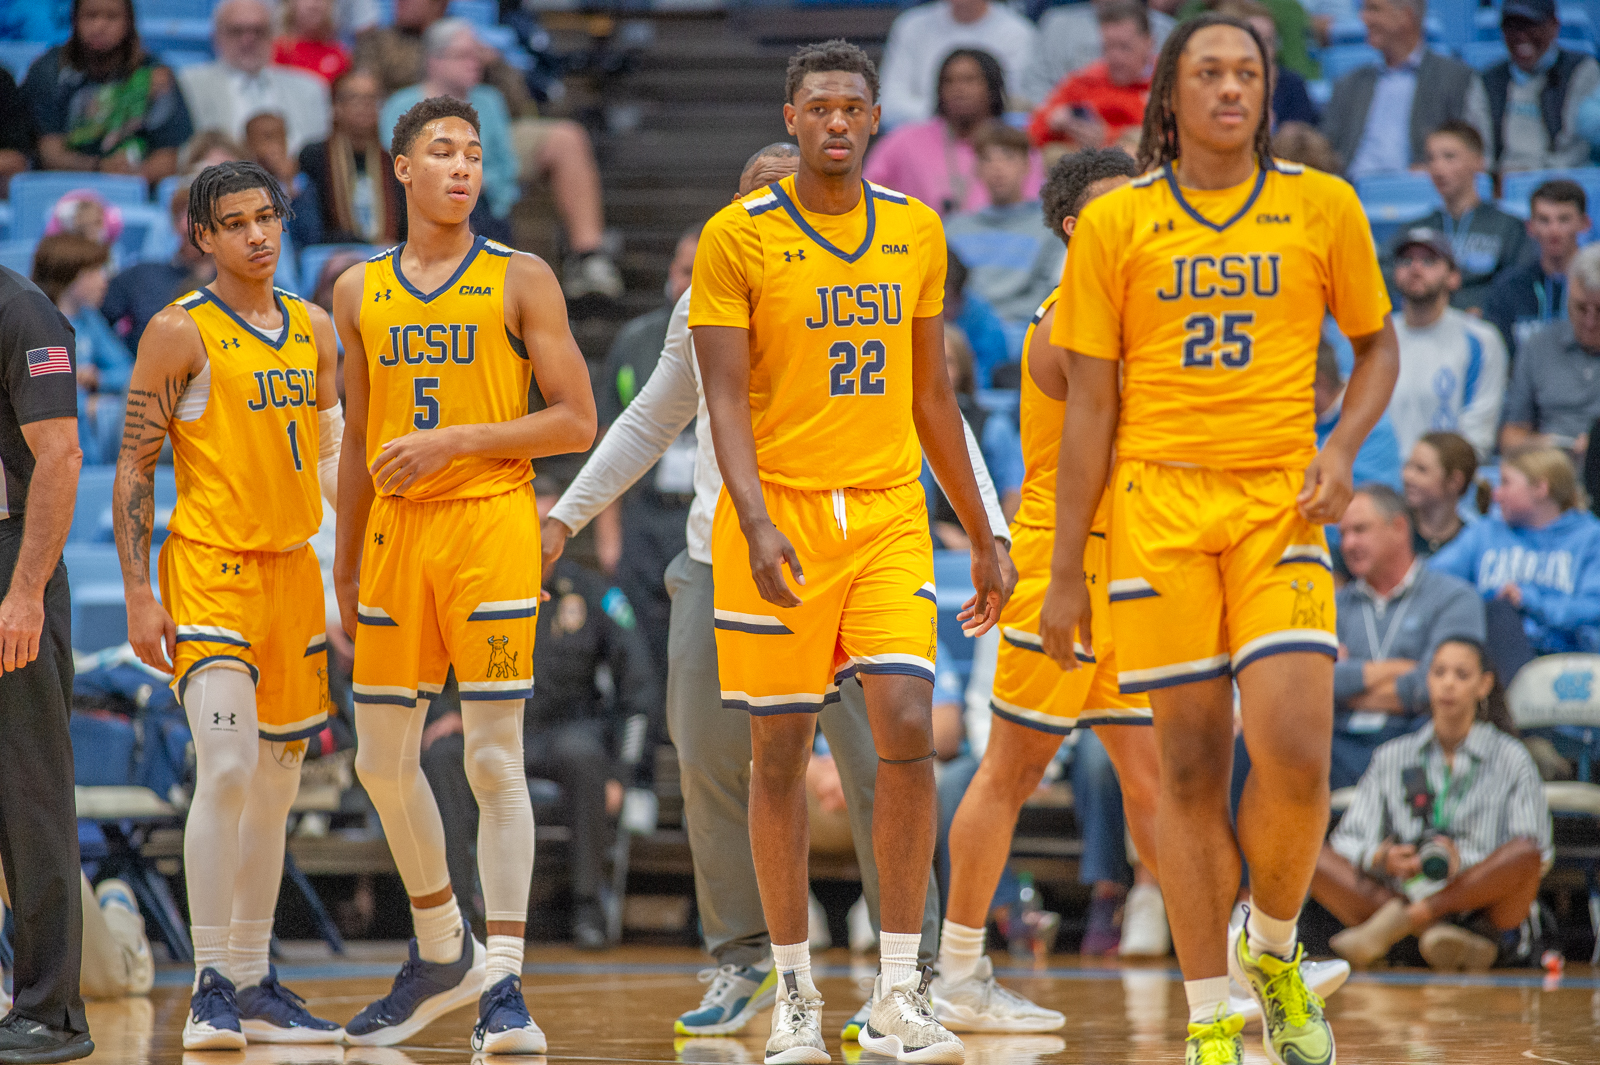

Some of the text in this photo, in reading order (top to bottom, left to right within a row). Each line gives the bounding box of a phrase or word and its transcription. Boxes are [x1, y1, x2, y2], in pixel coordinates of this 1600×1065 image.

[1256, 214, 1291, 224] CIAA
[881, 244, 909, 255] CIAA
[459, 285, 492, 296] CIAA
[1156, 252, 1282, 301] JCSU
[805, 283, 903, 330] JCSU
[379, 324, 478, 367] JCSU
[1180, 310, 1255, 372] 25
[247, 368, 317, 412] JCSU
[828, 338, 886, 397] 22
[413, 376, 440, 431] 5
[286, 419, 302, 471] 1
